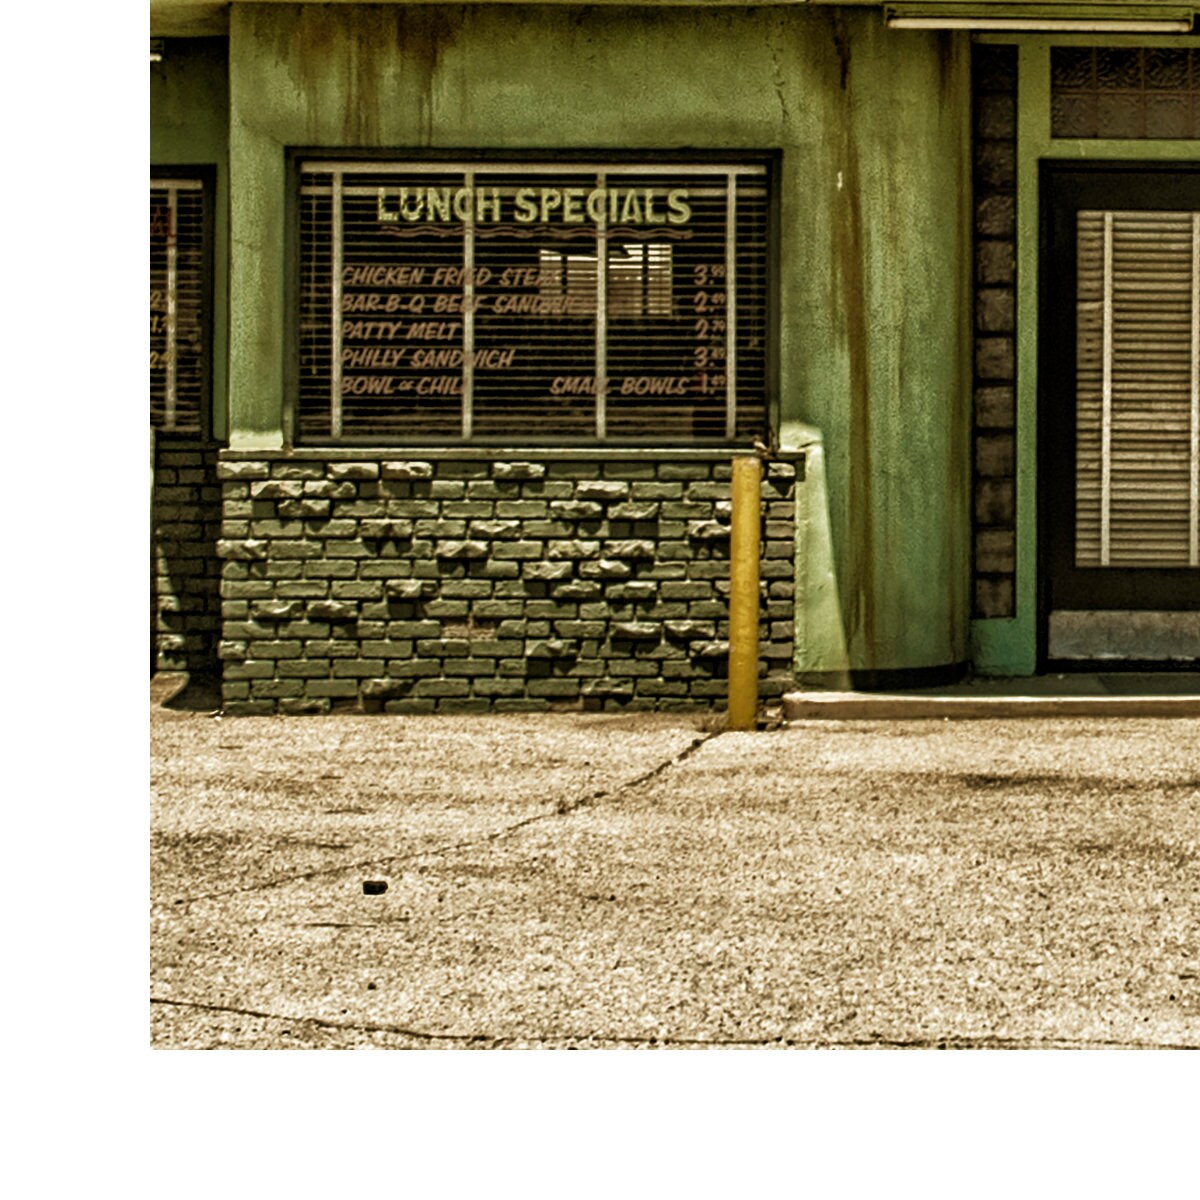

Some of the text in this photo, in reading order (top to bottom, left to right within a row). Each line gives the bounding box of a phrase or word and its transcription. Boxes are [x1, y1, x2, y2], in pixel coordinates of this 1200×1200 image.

[377, 187, 692, 224] LUNCH SPECIALS
[341, 266, 425, 286] CHICKEN
[341, 293, 426, 313] BAR-B-Q
[342, 320, 402, 340] PATTY
[406, 321, 462, 340] MELT
[340, 348, 406, 368] PHILLY
[340, 376, 395, 395] BOWL
[620, 376, 690, 395] BOWLS
